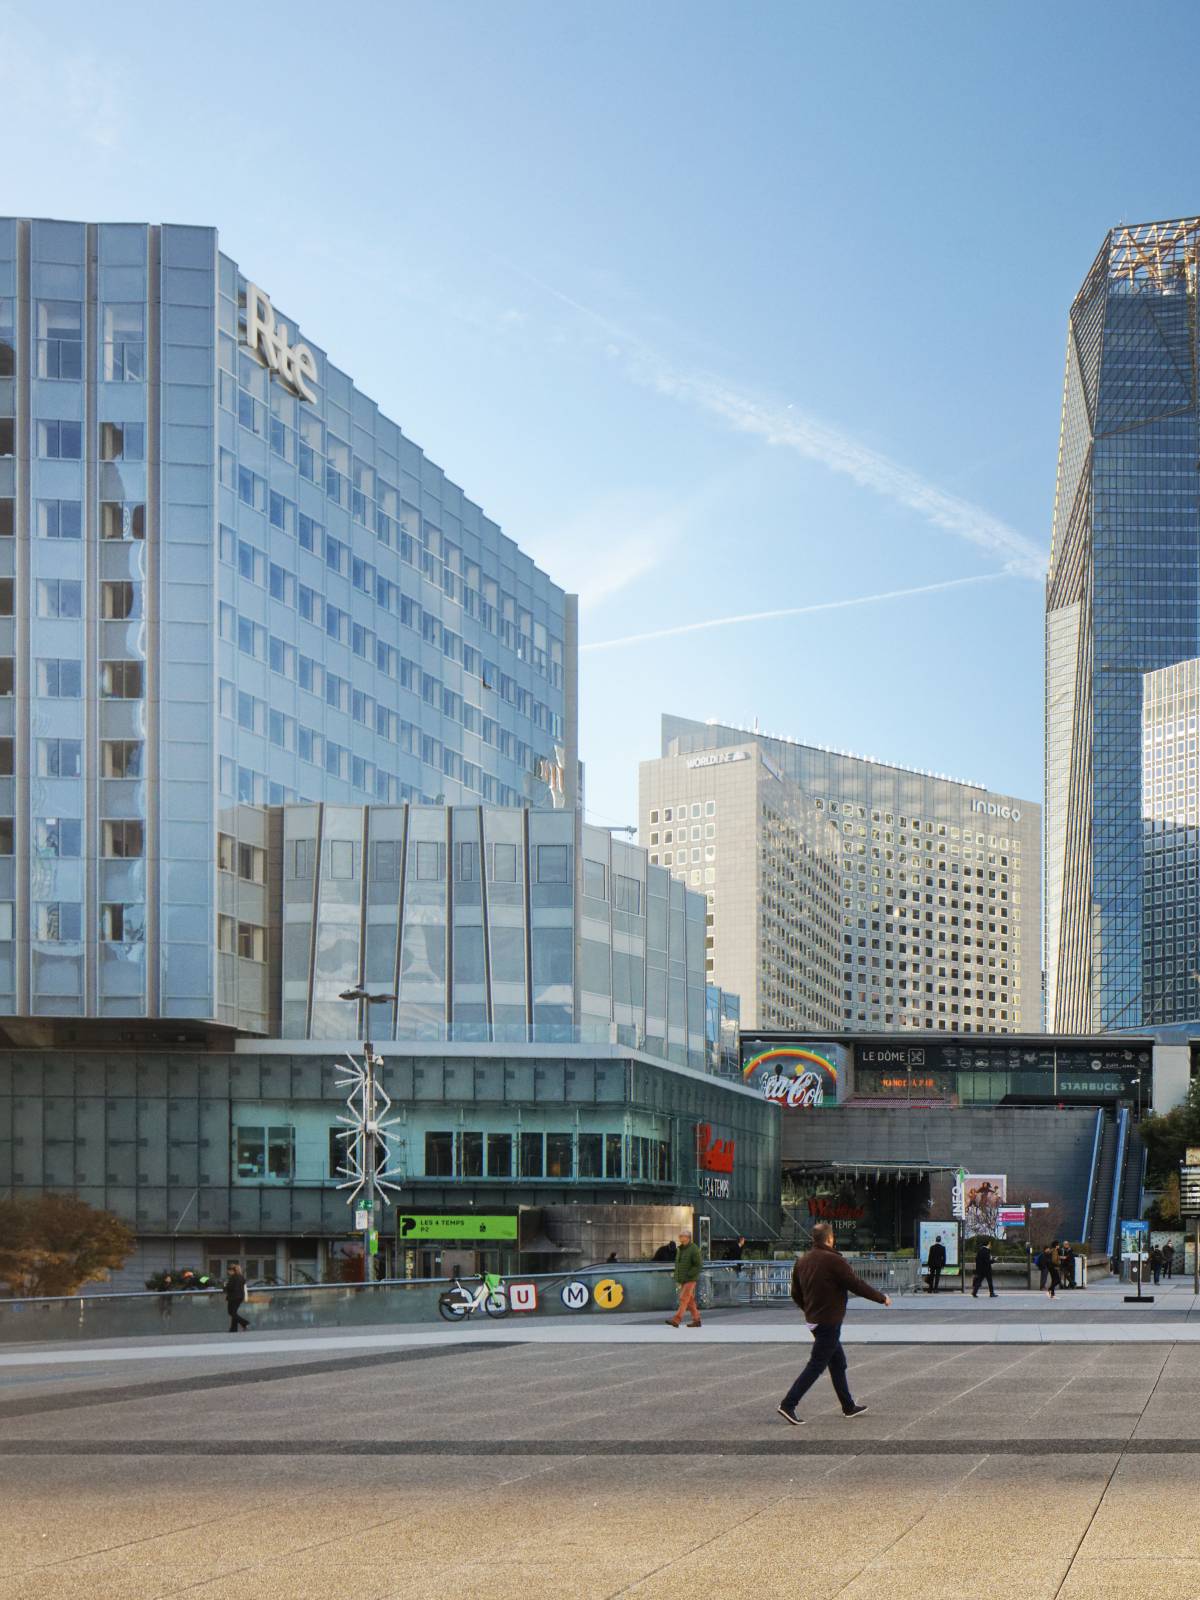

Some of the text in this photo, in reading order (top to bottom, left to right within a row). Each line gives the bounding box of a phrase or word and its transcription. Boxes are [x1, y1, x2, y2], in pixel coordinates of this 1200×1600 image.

[246, 281, 318, 405] Rte
[862, 1049, 905, 1062] LE DÔME
[1060, 1082, 1125, 1091] STARBUCKS
[952, 1186, 962, 1217] INFO
[402, 1218, 416, 1236] P
[517, 1290, 530, 1304] U
[568, 1287, 583, 1303] M
